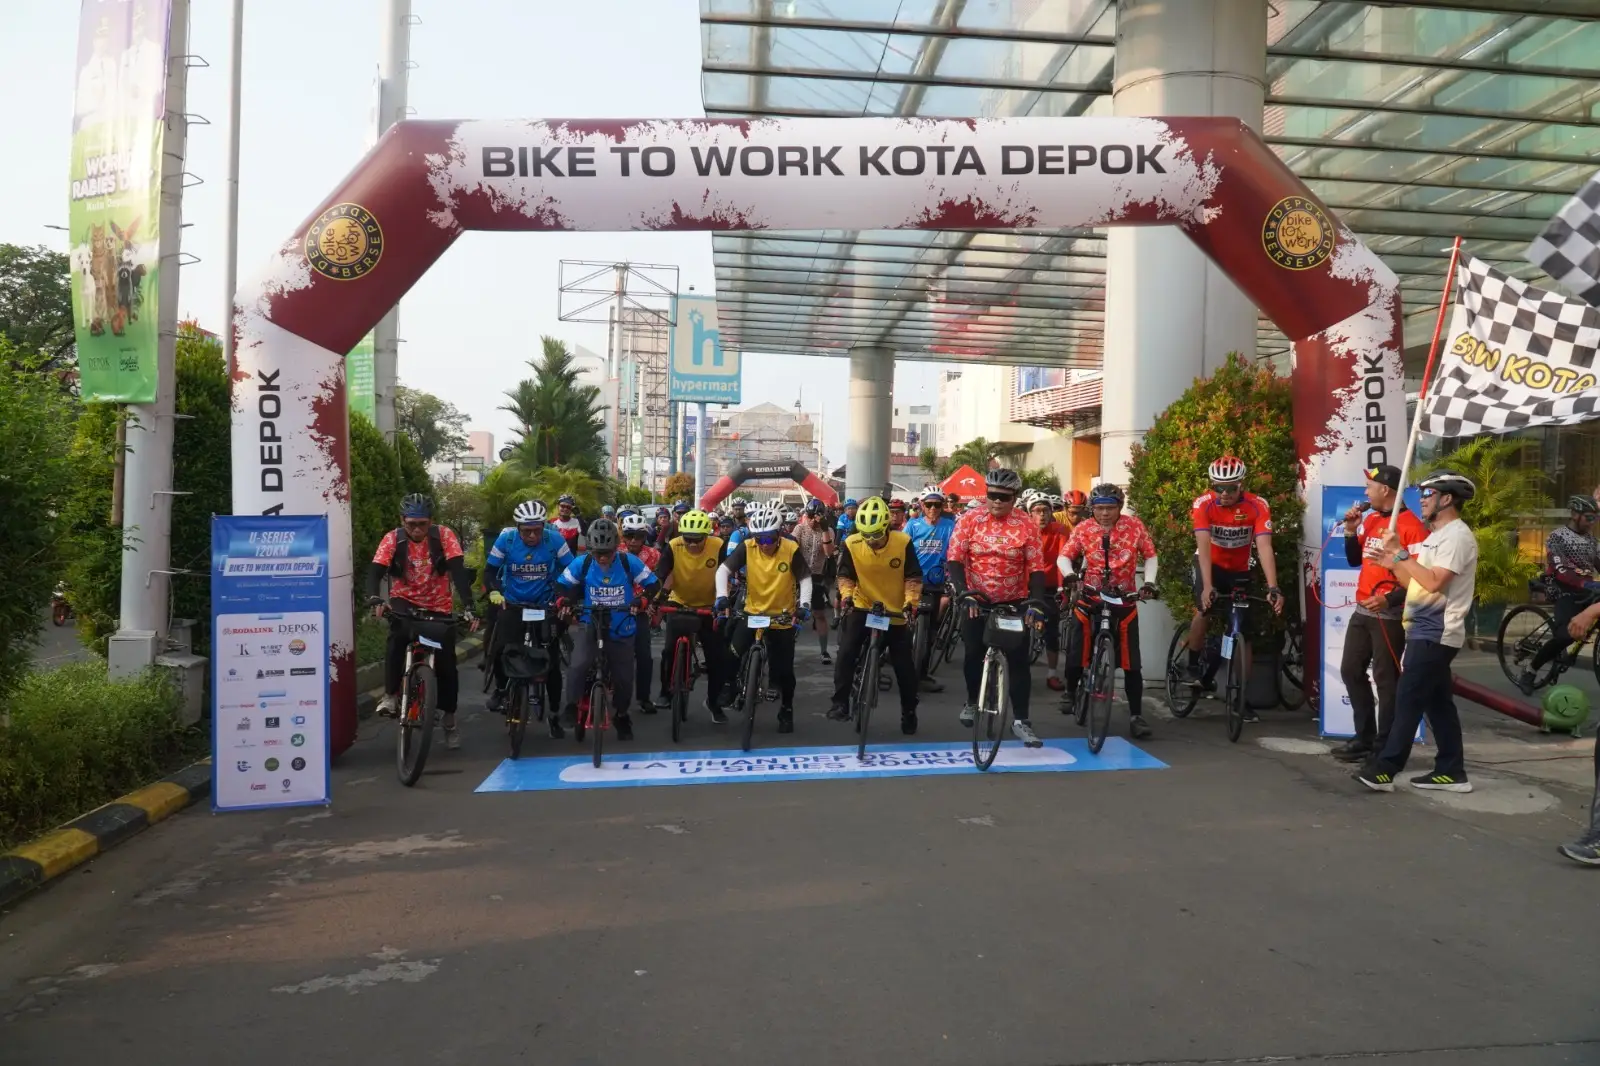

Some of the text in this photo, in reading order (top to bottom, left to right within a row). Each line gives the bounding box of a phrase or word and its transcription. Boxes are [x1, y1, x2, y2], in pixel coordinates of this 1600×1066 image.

[482, 144, 1167, 177] BIKE TO WORK KOTA DEPOK
[1273, 199, 1324, 219] DEPOK
[1286, 214, 1312, 226] bike
[307, 213, 330, 271] DEPOK
[322, 228, 336, 256] bike
[339, 206, 381, 277] BERSEPEDA
[346, 220, 360, 257] work
[1285, 236, 1318, 249] work
[1265, 229, 1333, 268] BERSEPEDA
[1451, 331, 1501, 372] B2W
[672, 376, 739, 393] hypermart
[1363, 351, 1388, 470] DEPOK
[258, 368, 284, 492] DEPOK
[249, 531, 296, 544] U-SERIES
[255, 545, 290, 557] 120KM
[229, 561, 315, 572] BIKE TO WORK KOTA DEPOK
[511, 564, 548, 573] U-SERIES
[590, 586, 625, 596] U-SERIES
[278, 623, 319, 633] DEPOK
[622, 757, 778, 770] LATIHAN
[679, 757, 974, 774] U-SERIES 300KM
